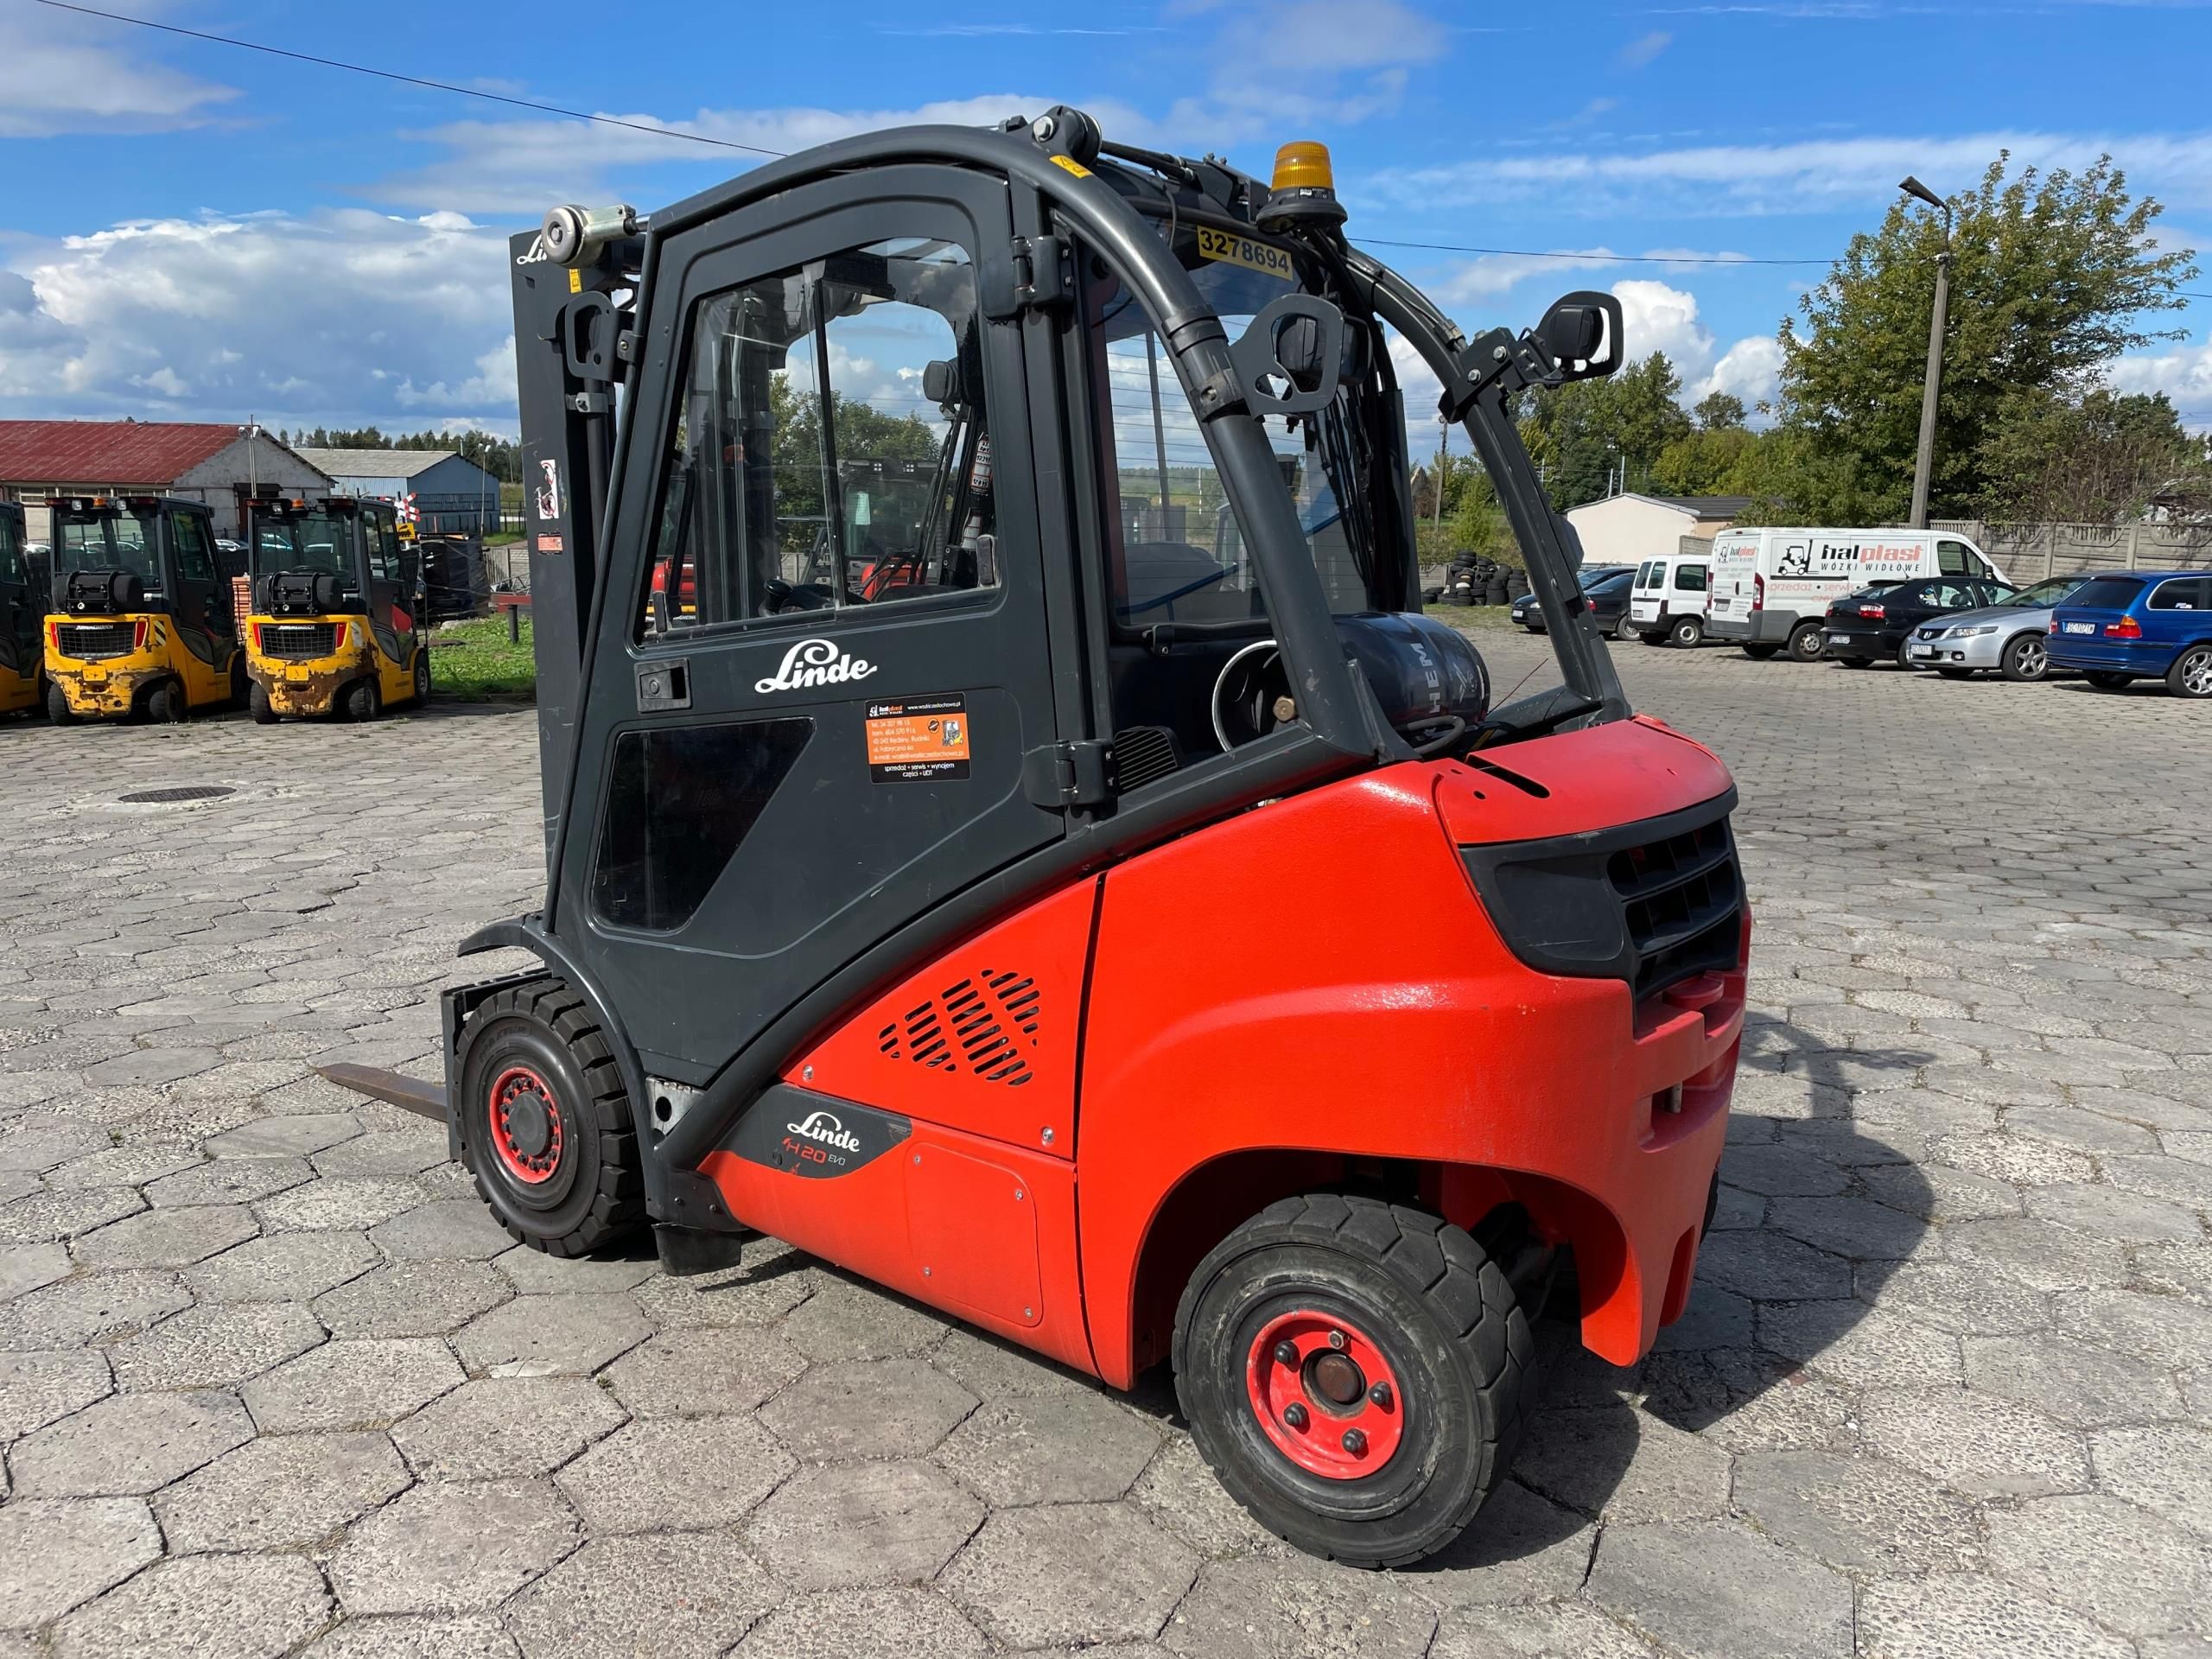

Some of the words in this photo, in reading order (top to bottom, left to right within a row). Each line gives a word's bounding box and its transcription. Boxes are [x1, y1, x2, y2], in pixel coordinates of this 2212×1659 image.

[1199, 230, 1289, 273] 3278694
[1821, 544, 1923, 563] halplast
[1821, 563, 1858, 571] WÓZKI
[1866, 563, 1920, 572] WIDŁOWE
[1766, 582, 1813, 592] sprzedaż
[1824, 582, 1855, 591] serwis
[754, 639, 877, 693] Linde
[786, 1111, 860, 1152] Linde
[828, 1154, 846, 1166] EVO
